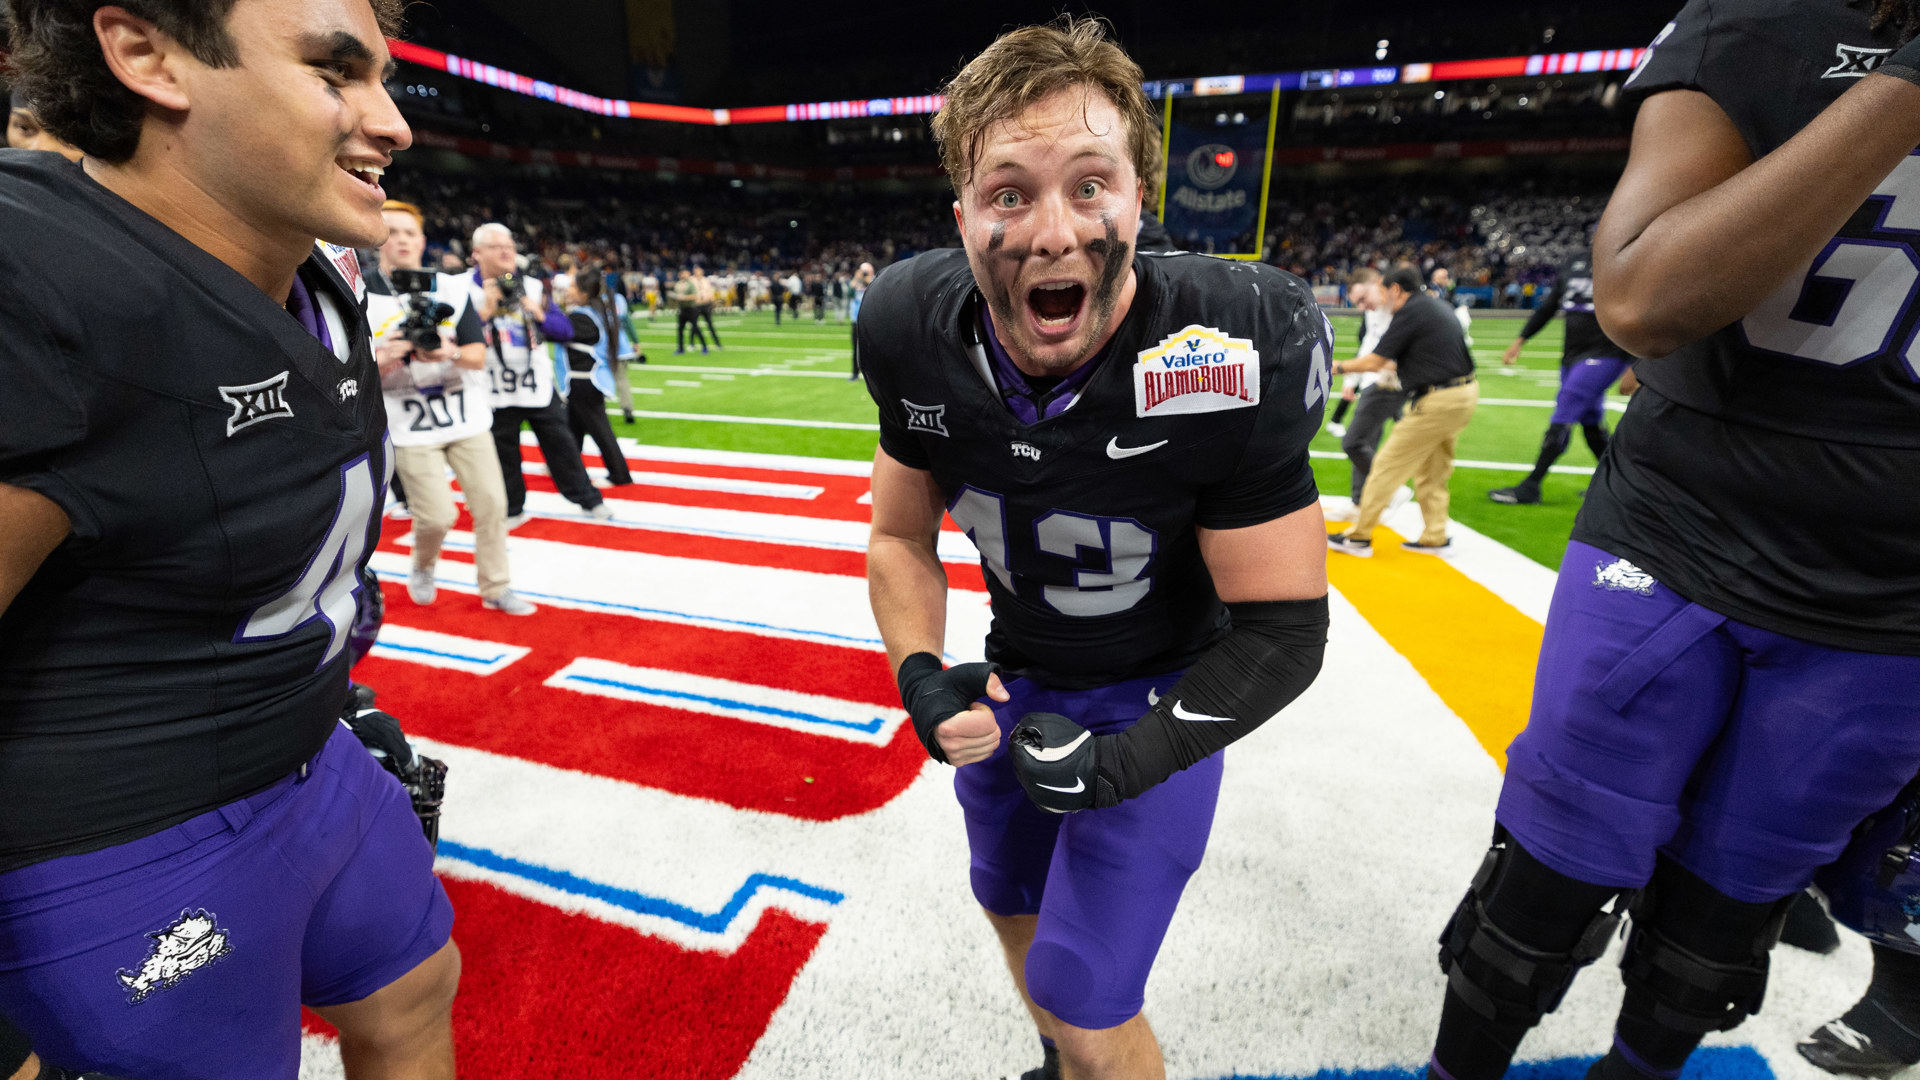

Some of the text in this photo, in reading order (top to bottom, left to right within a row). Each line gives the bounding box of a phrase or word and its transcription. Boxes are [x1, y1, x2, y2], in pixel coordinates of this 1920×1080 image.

[1162, 351, 1225, 369] Valero
[488, 368, 538, 394] 194
[403, 389, 466, 431] 207
[1011, 443, 1042, 462] TCU
